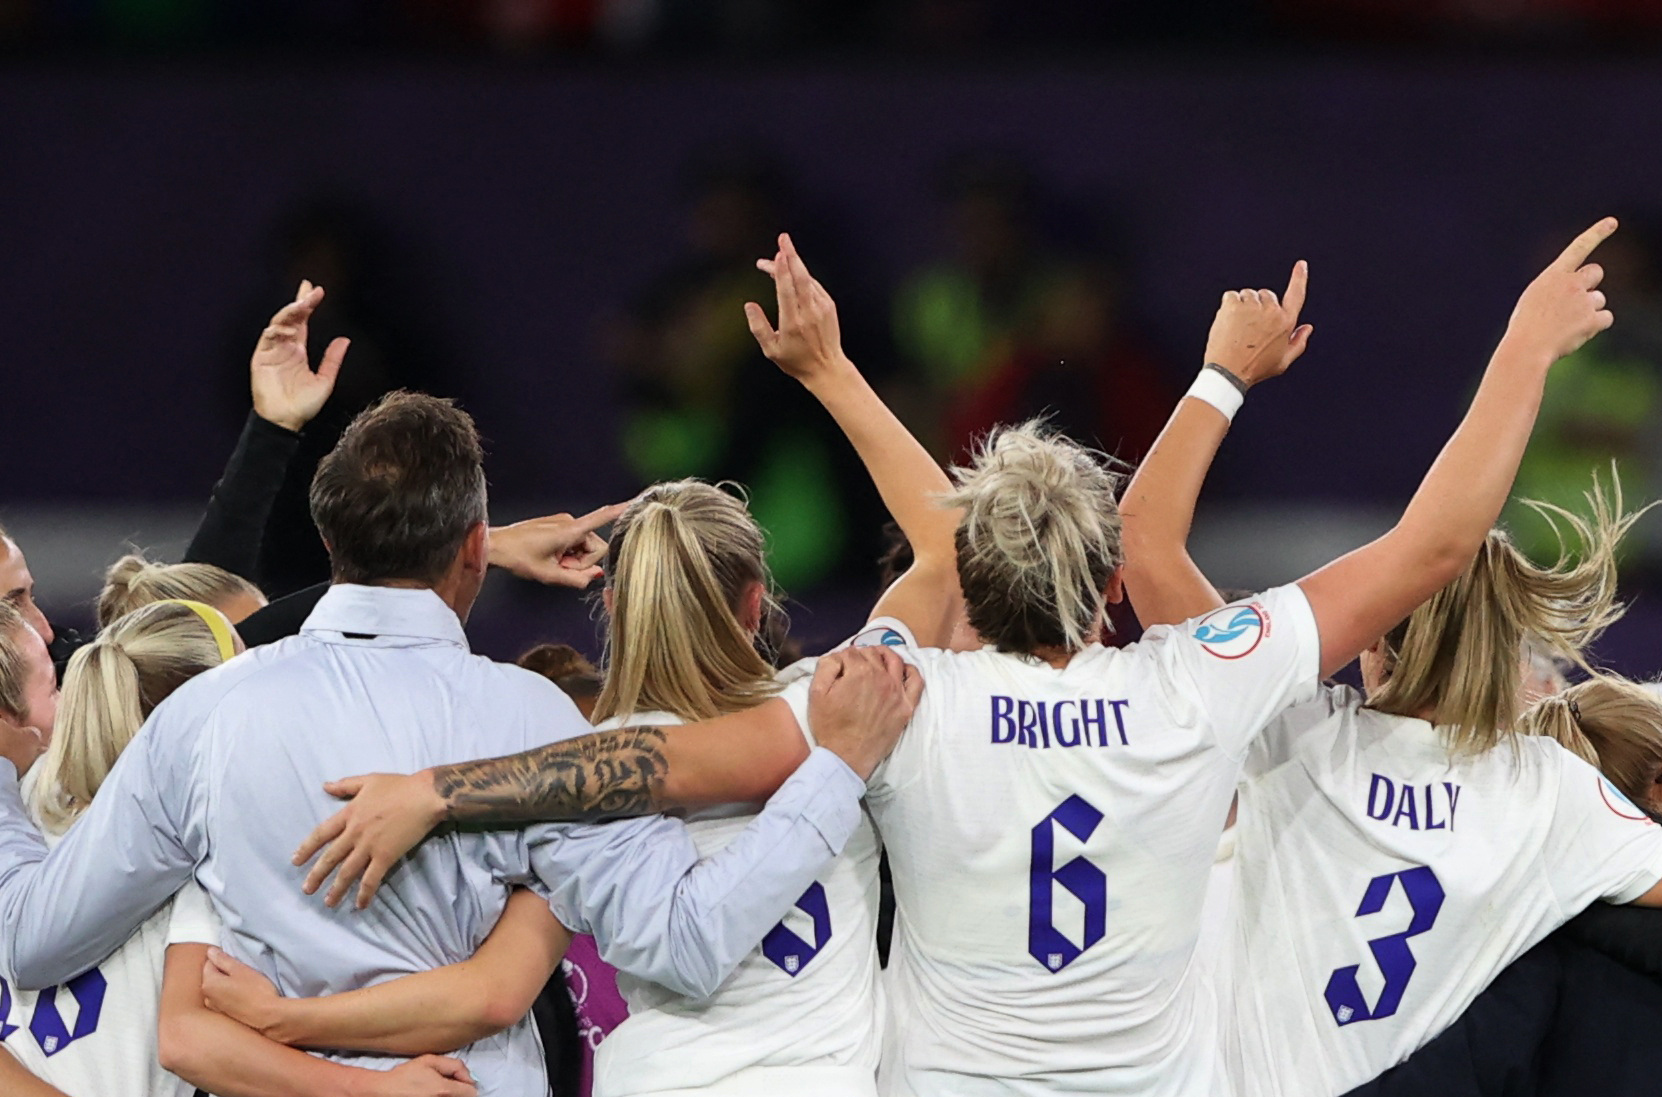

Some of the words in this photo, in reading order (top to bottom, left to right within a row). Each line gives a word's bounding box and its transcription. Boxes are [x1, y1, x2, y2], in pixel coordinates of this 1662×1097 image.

[990, 695, 1130, 749] BRIGHT
[1366, 772, 1462, 832] DALY
[1028, 792, 1107, 974] 6
[1323, 865, 1446, 1027] 3
